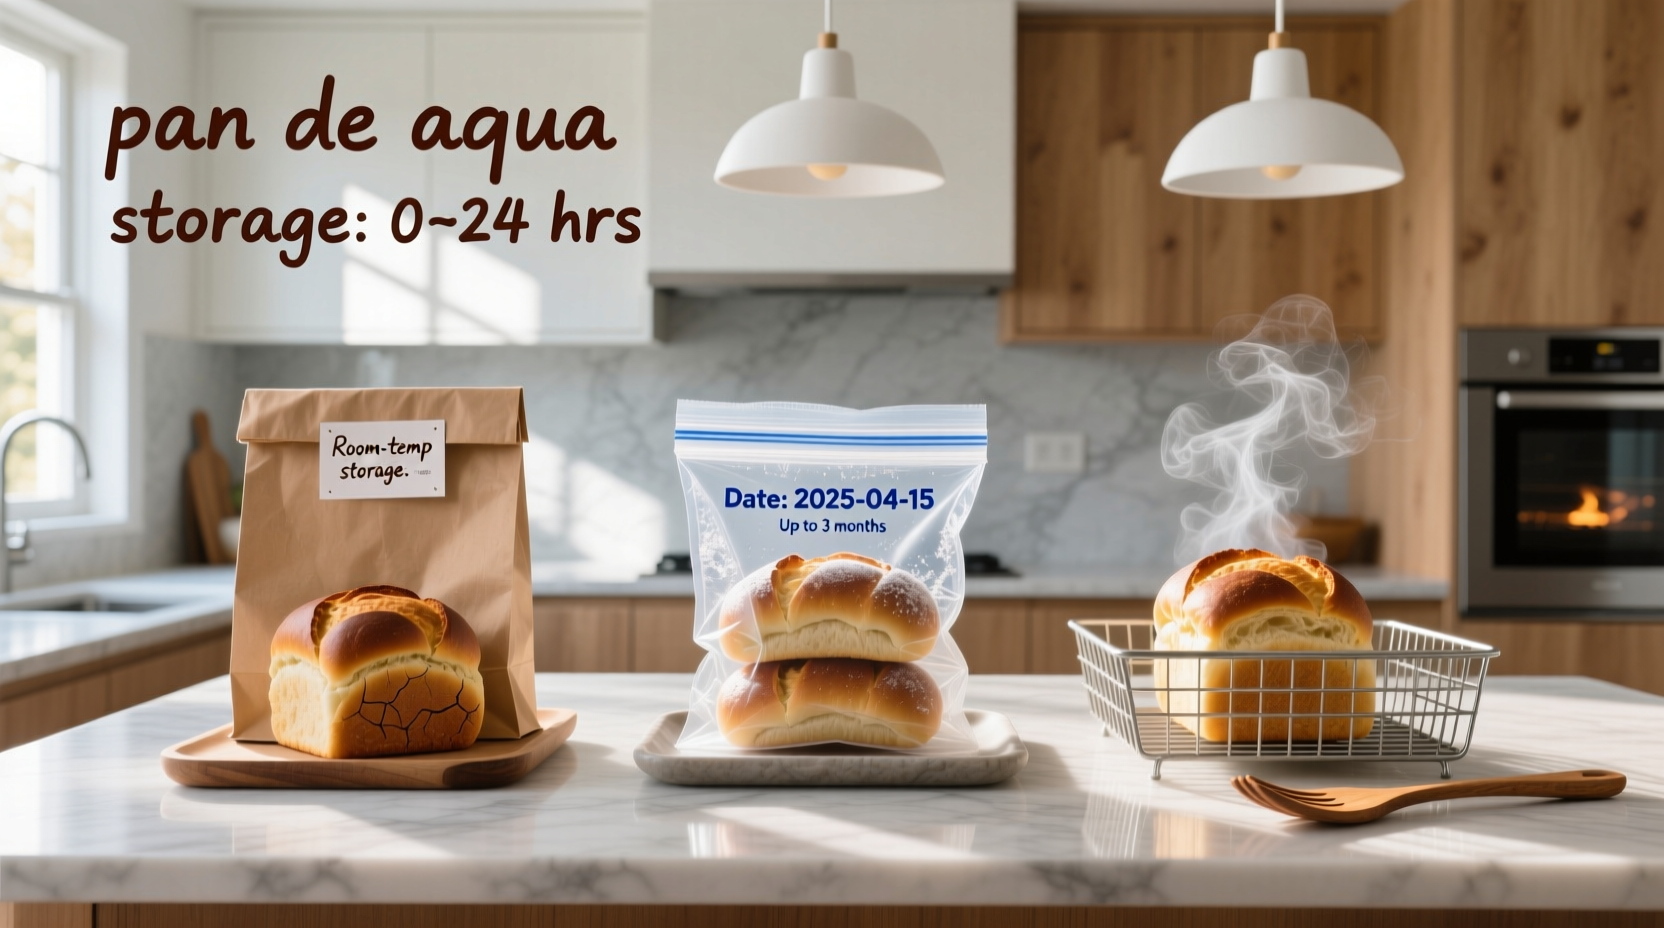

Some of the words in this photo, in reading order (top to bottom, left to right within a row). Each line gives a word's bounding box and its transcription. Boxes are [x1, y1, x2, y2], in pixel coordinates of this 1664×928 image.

[332, 435, 432, 462] Room-temp
[340, 463, 409, 485] storage.
[725, 487, 788, 509] Date:
[794, 487, 934, 510] 2025-04-15
[779, 517, 799, 535] Up
[803, 520, 817, 532] to
[821, 518, 831, 532] 3
[834, 518, 886, 533] months
